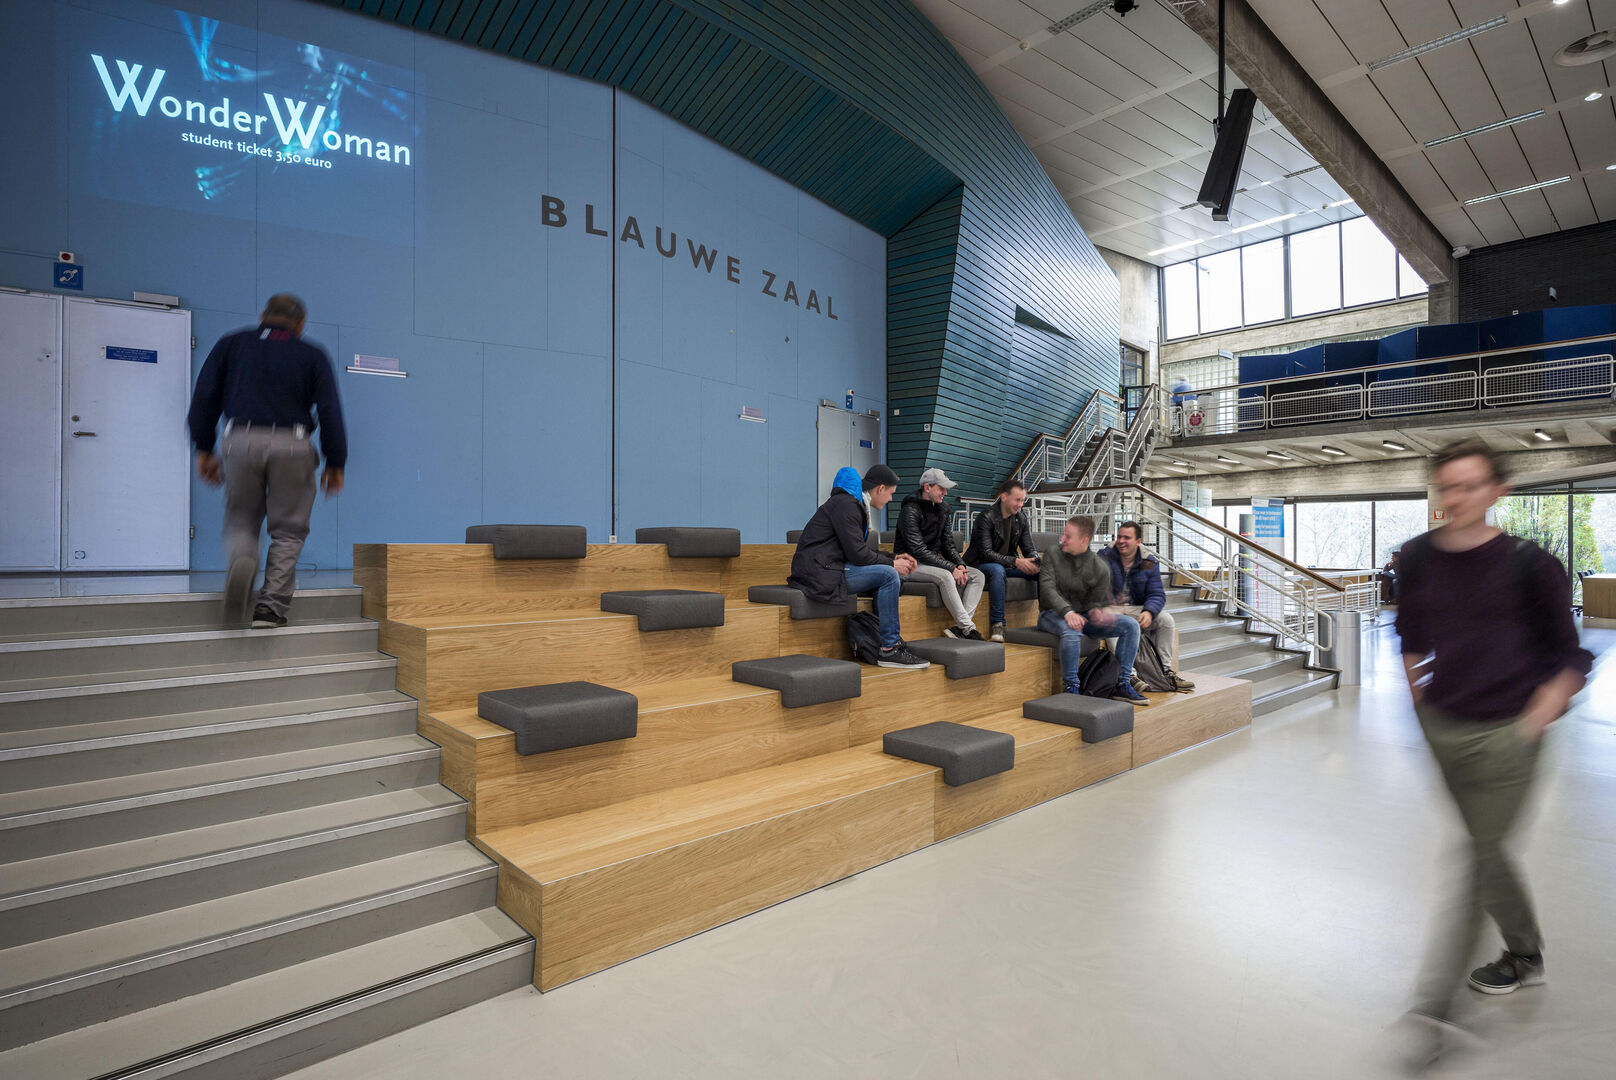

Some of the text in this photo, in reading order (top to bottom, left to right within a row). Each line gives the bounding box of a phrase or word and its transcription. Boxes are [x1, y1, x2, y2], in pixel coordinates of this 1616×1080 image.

[181, 132, 332, 169] student ticket 3,50 euro
[541, 194, 838, 319] BLAUWE ZAAL
